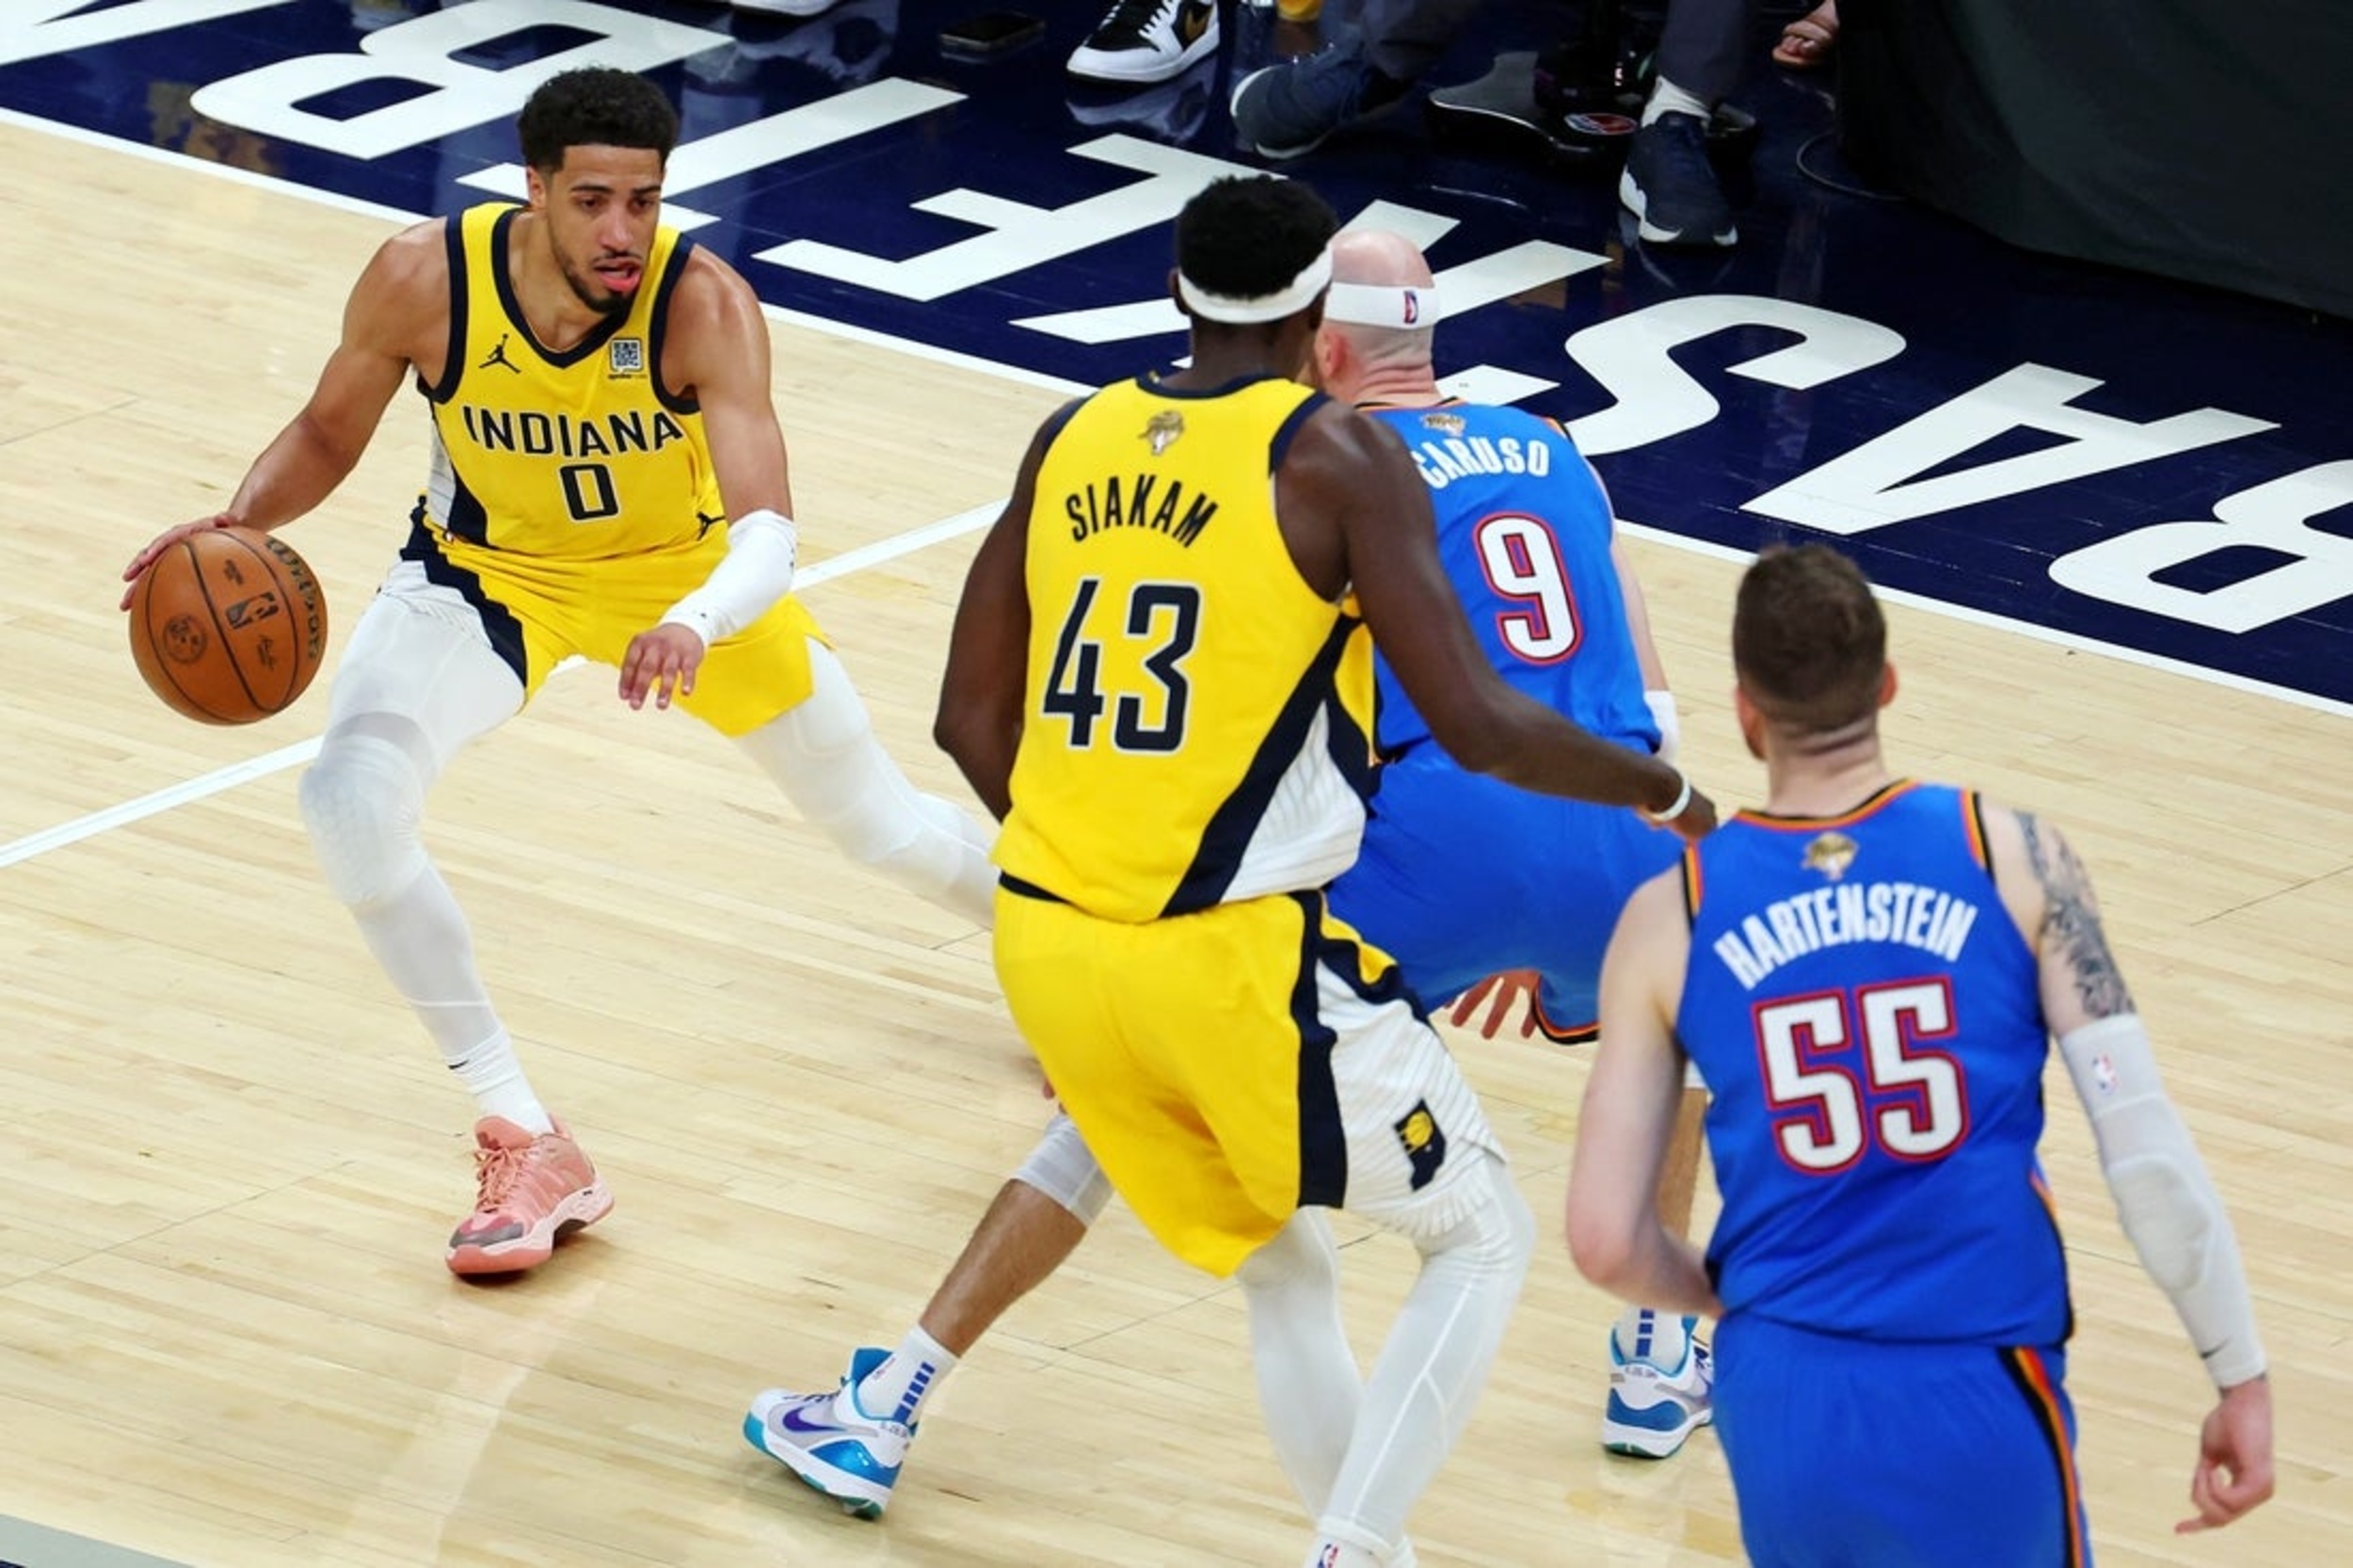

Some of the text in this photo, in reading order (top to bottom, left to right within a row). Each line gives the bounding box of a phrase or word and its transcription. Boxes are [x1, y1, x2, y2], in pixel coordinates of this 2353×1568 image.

[461, 405, 684, 458] INDIANA
[1410, 436, 1550, 489] CARUSO
[559, 463, 619, 522] 0
[1064, 473, 1219, 549] SIAKAM
[1472, 511, 1584, 665] 9
[1041, 577, 1202, 755] 43
[1713, 881, 1978, 990] HARTENSTEIN
[1752, 974, 1970, 1177] 55
